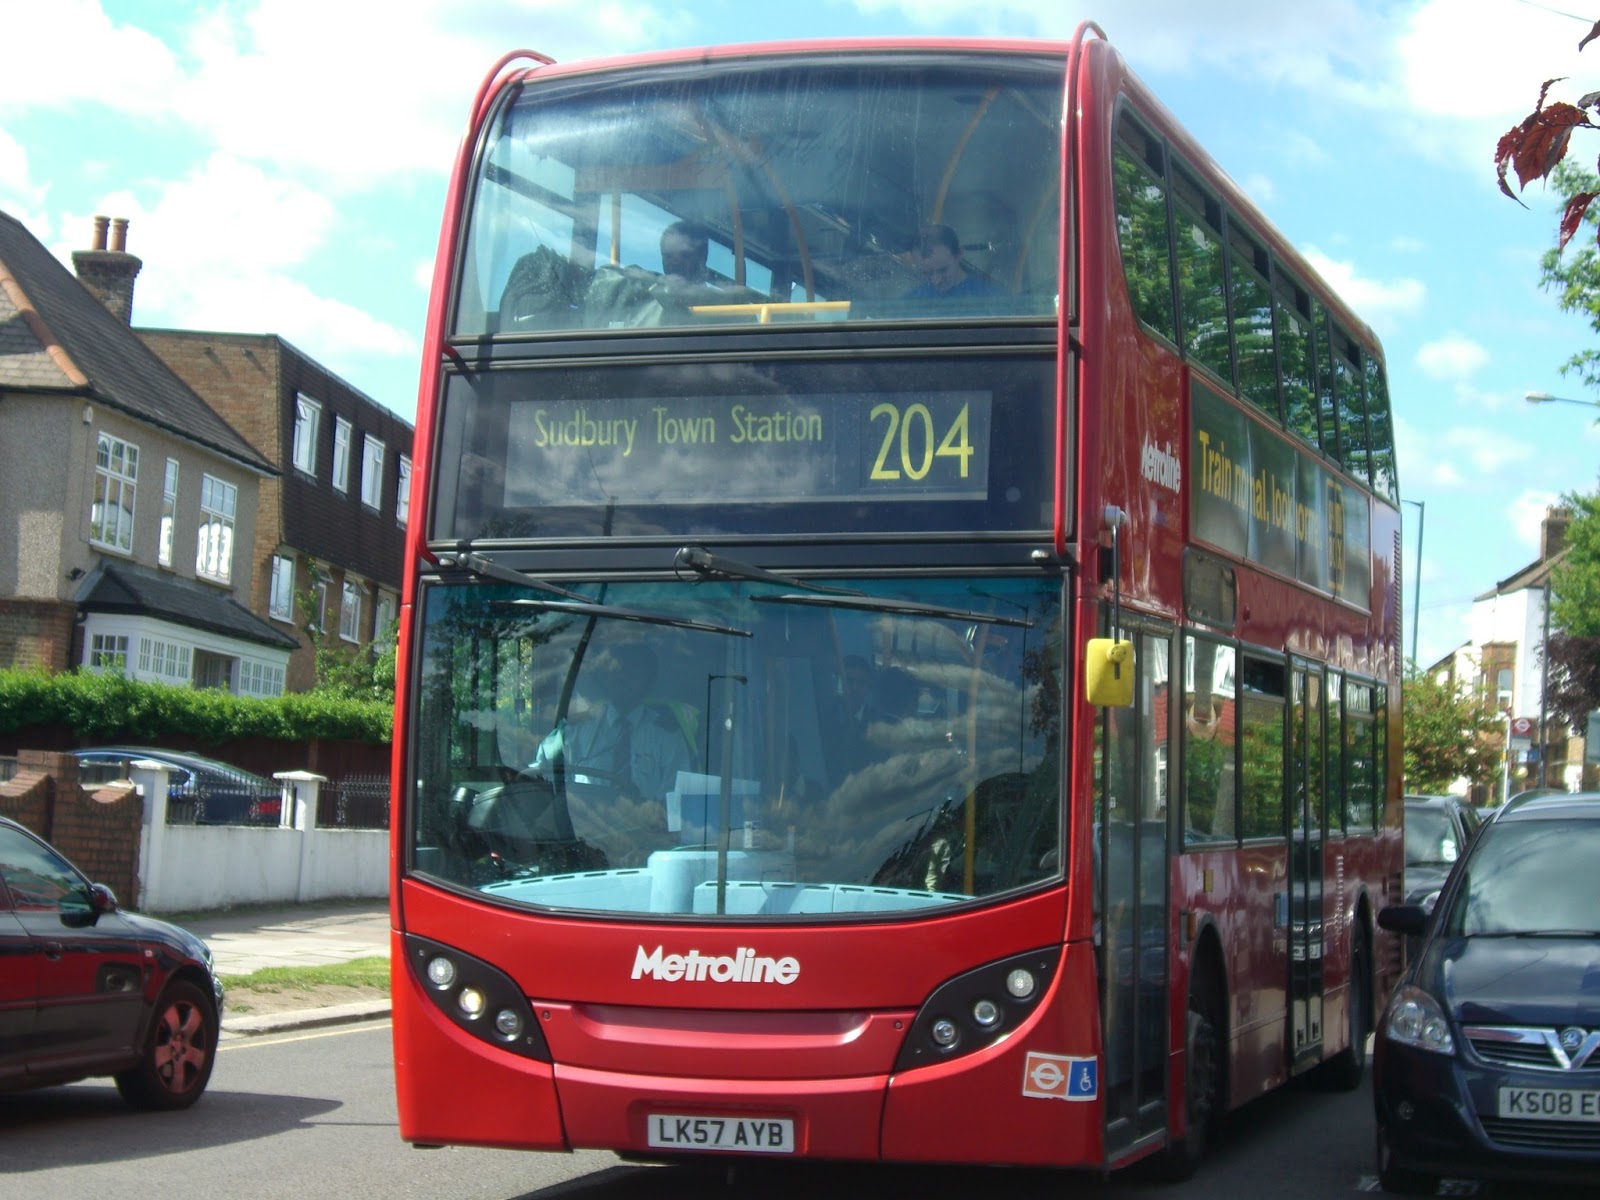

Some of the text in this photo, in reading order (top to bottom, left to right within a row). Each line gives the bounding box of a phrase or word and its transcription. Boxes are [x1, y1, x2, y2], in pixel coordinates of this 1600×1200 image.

[534, 402, 975, 481] Sudbury Town Station 204
[1140, 430, 1182, 495] Metroline
[1199, 430, 1232, 502] Train
[630, 944, 801, 985] Metroline
[1509, 1090, 1600, 1117] KS08 E
[659, 1118, 784, 1147] LK57 AYB
